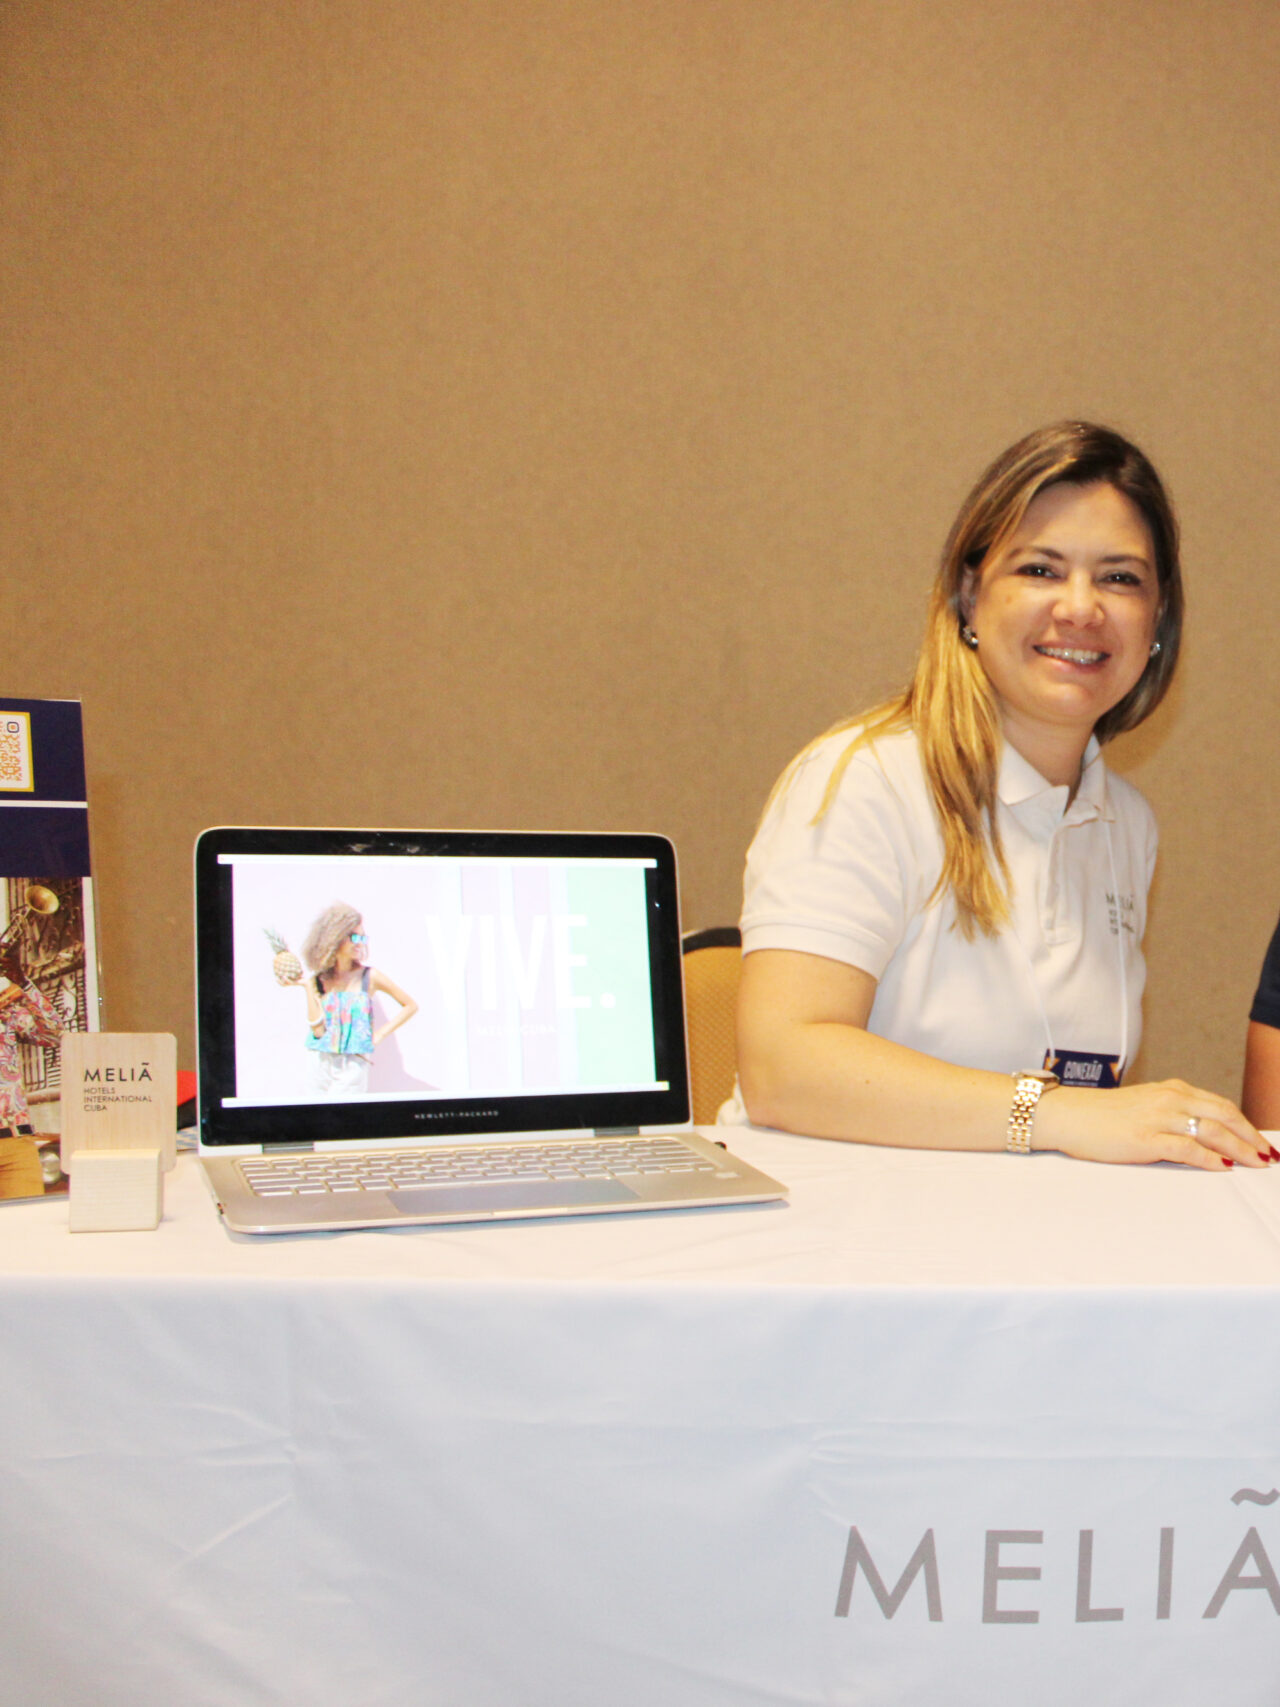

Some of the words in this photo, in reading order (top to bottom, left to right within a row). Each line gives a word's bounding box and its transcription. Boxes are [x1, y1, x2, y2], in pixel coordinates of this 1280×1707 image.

[424, 913, 616, 1010] VIVE.
[84, 1062, 153, 1082] MELIÃ
[1063, 1060, 1103, 1081] CONEXÃO
[84, 1087, 116, 1095] HOTELS
[84, 1095, 153, 1103] INTERNATIONAL
[84, 1104, 108, 1112] CUBA
